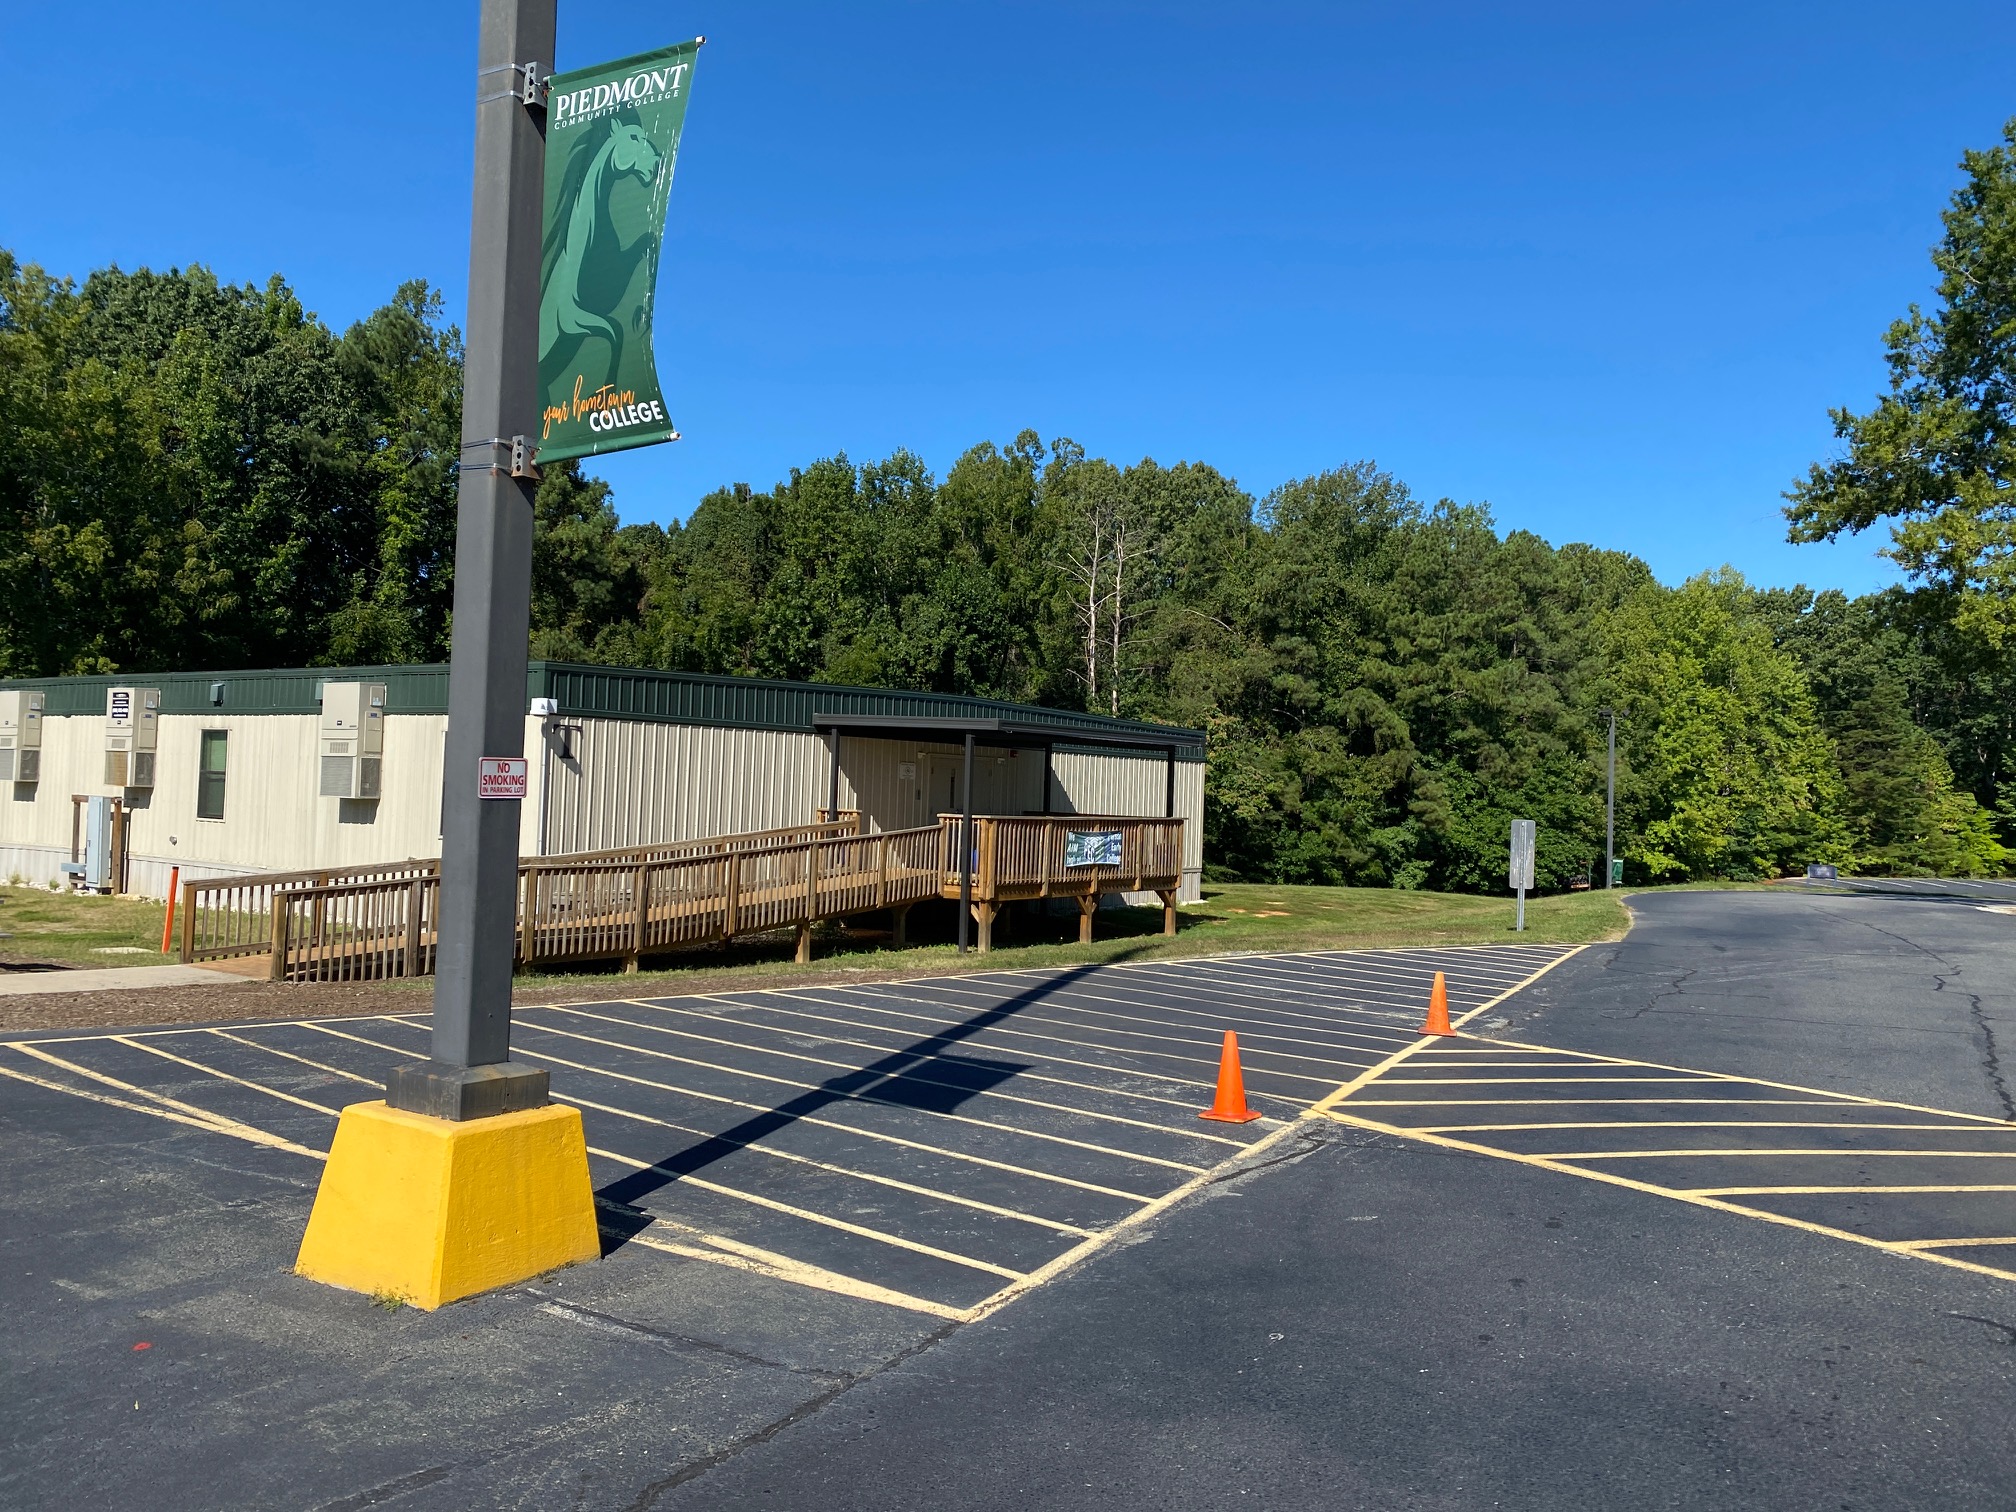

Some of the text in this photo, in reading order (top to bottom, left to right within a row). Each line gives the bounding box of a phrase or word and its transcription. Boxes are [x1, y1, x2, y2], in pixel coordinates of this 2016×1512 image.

[554, 63, 689, 121] PIEDMONT
[554, 89, 680, 130] COMMUNITY COLLEGE
[542, 400, 570, 440] your
[589, 400, 664, 432] COLLEGE
[483, 775, 524, 785] SMOKING
[497, 763, 511, 773] NO
